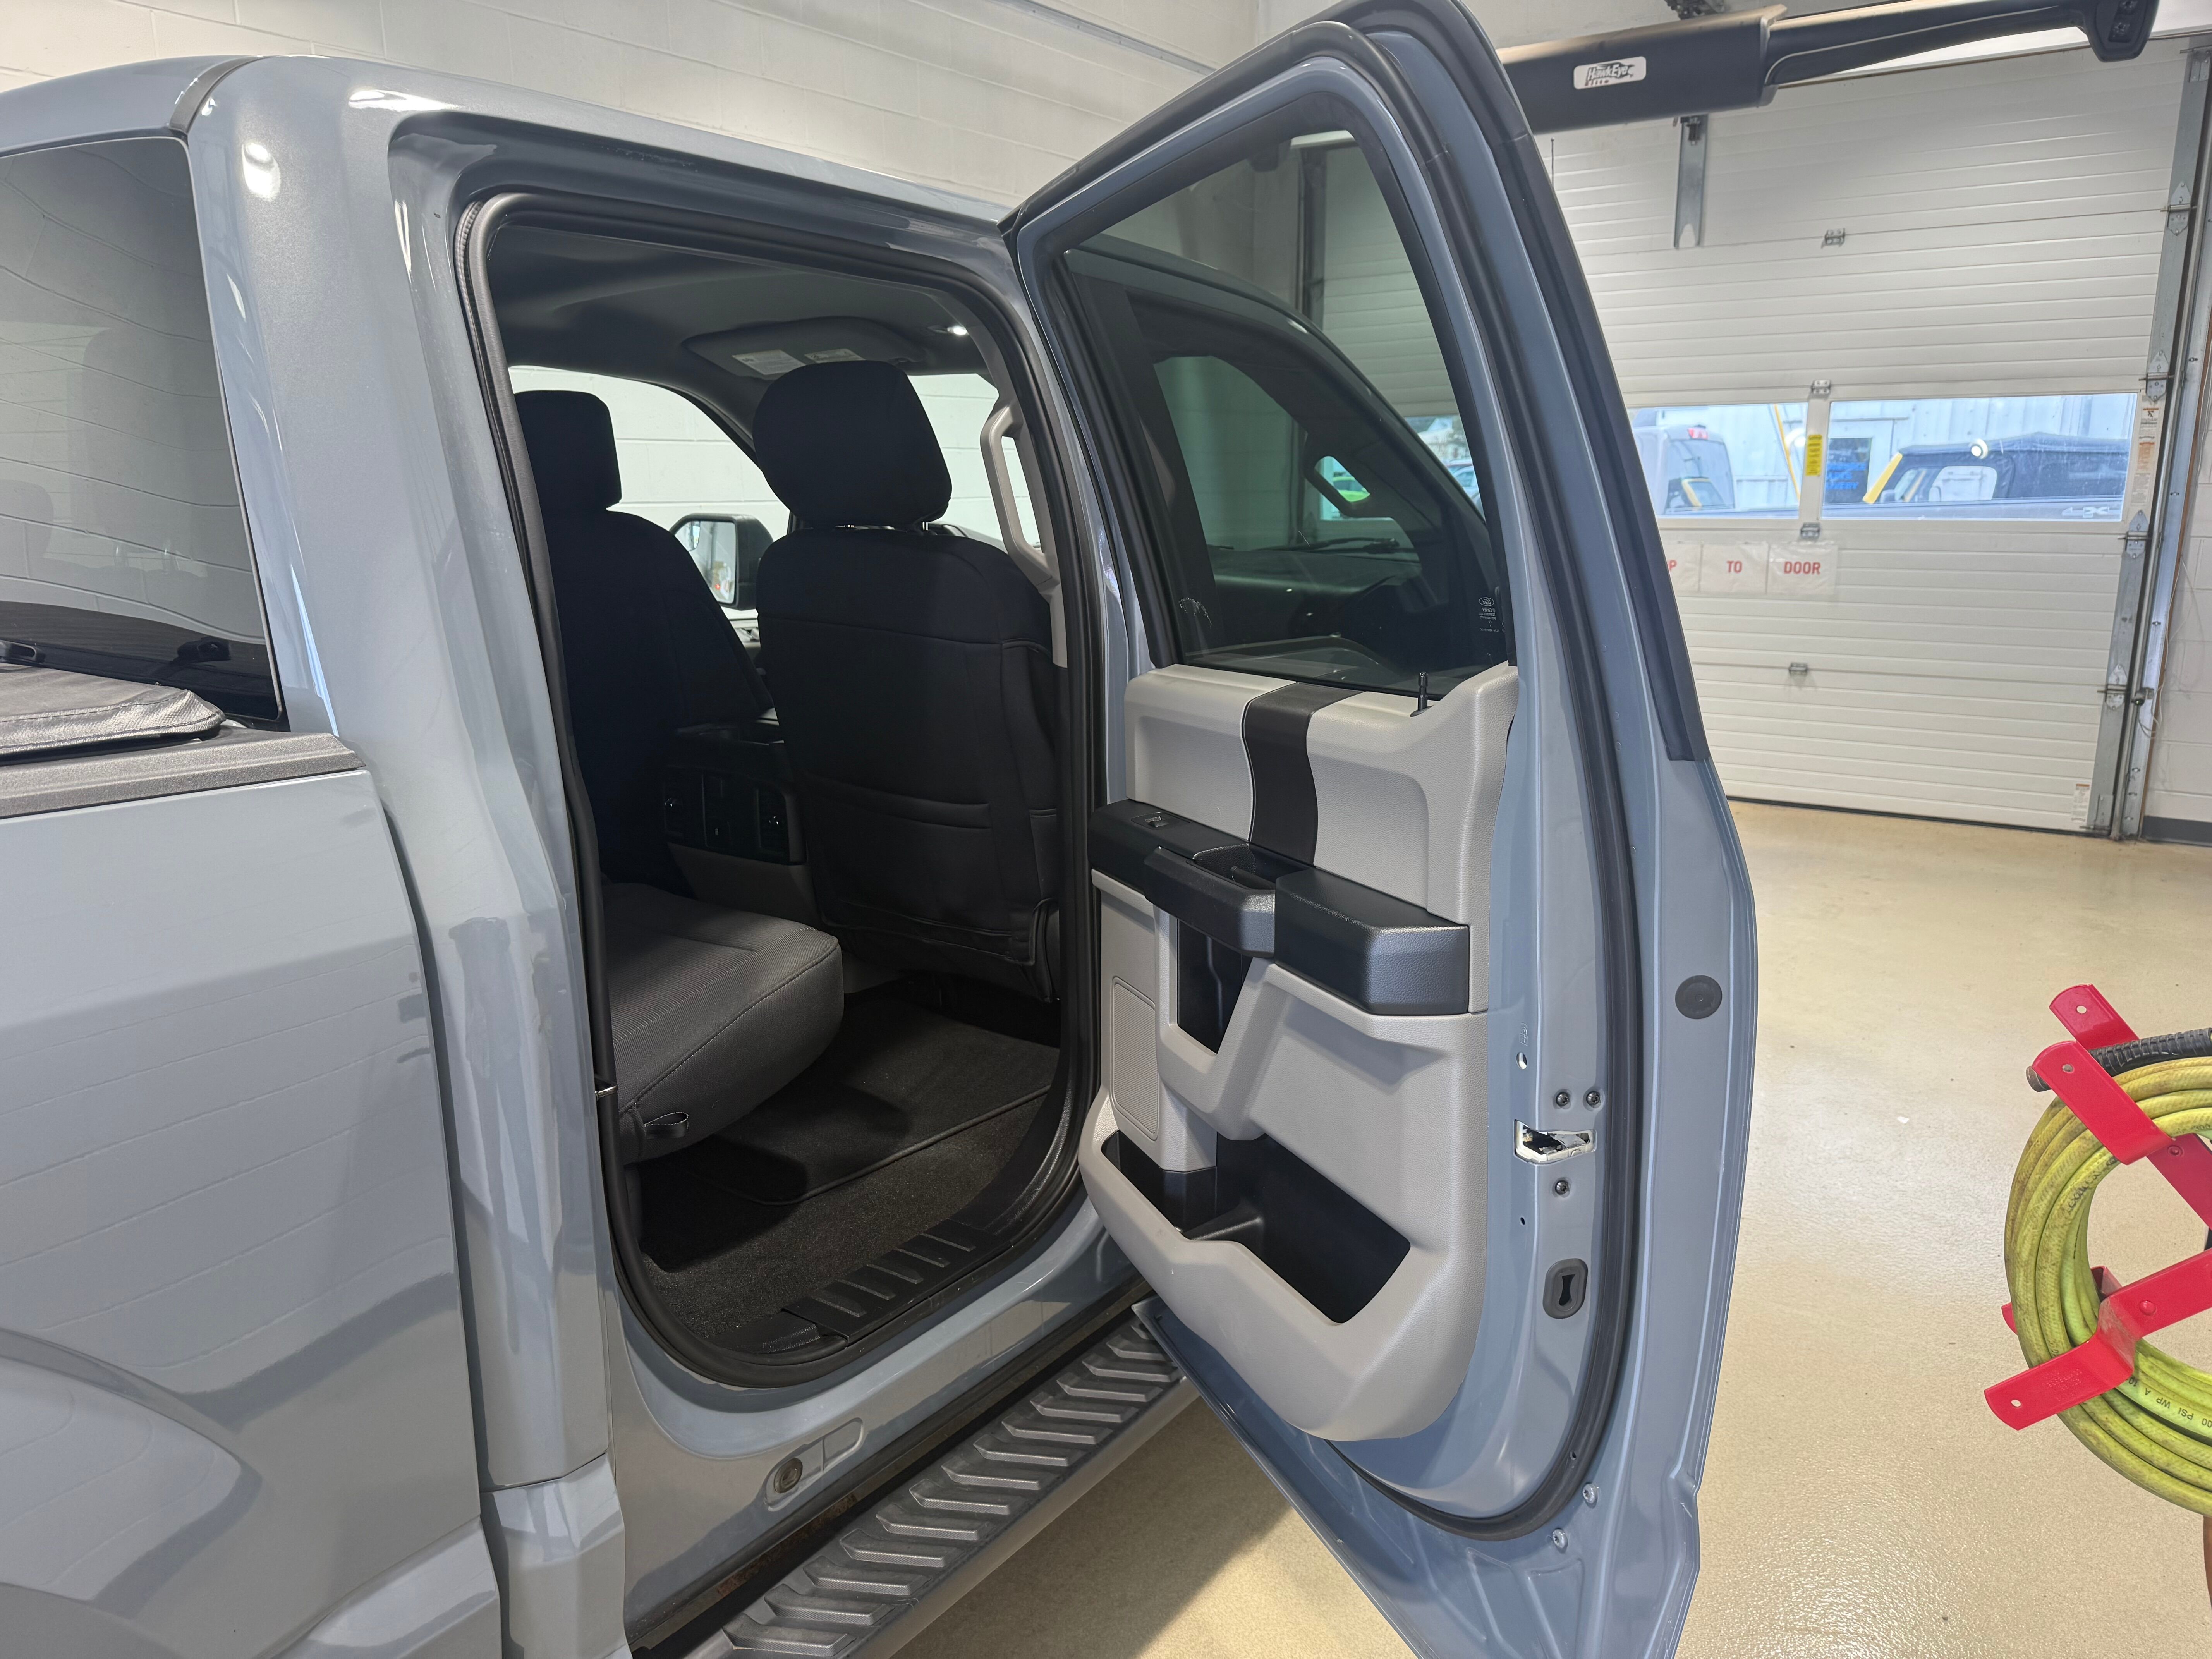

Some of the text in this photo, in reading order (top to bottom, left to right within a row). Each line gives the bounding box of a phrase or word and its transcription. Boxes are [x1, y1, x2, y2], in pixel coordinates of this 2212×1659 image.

[1668, 560, 1821, 575] P TO DOOR
[2145, 1388, 2152, 1396] A
[2156, 1397, 2171, 1409] WP
[2178, 1407, 2194, 1420] PSI
